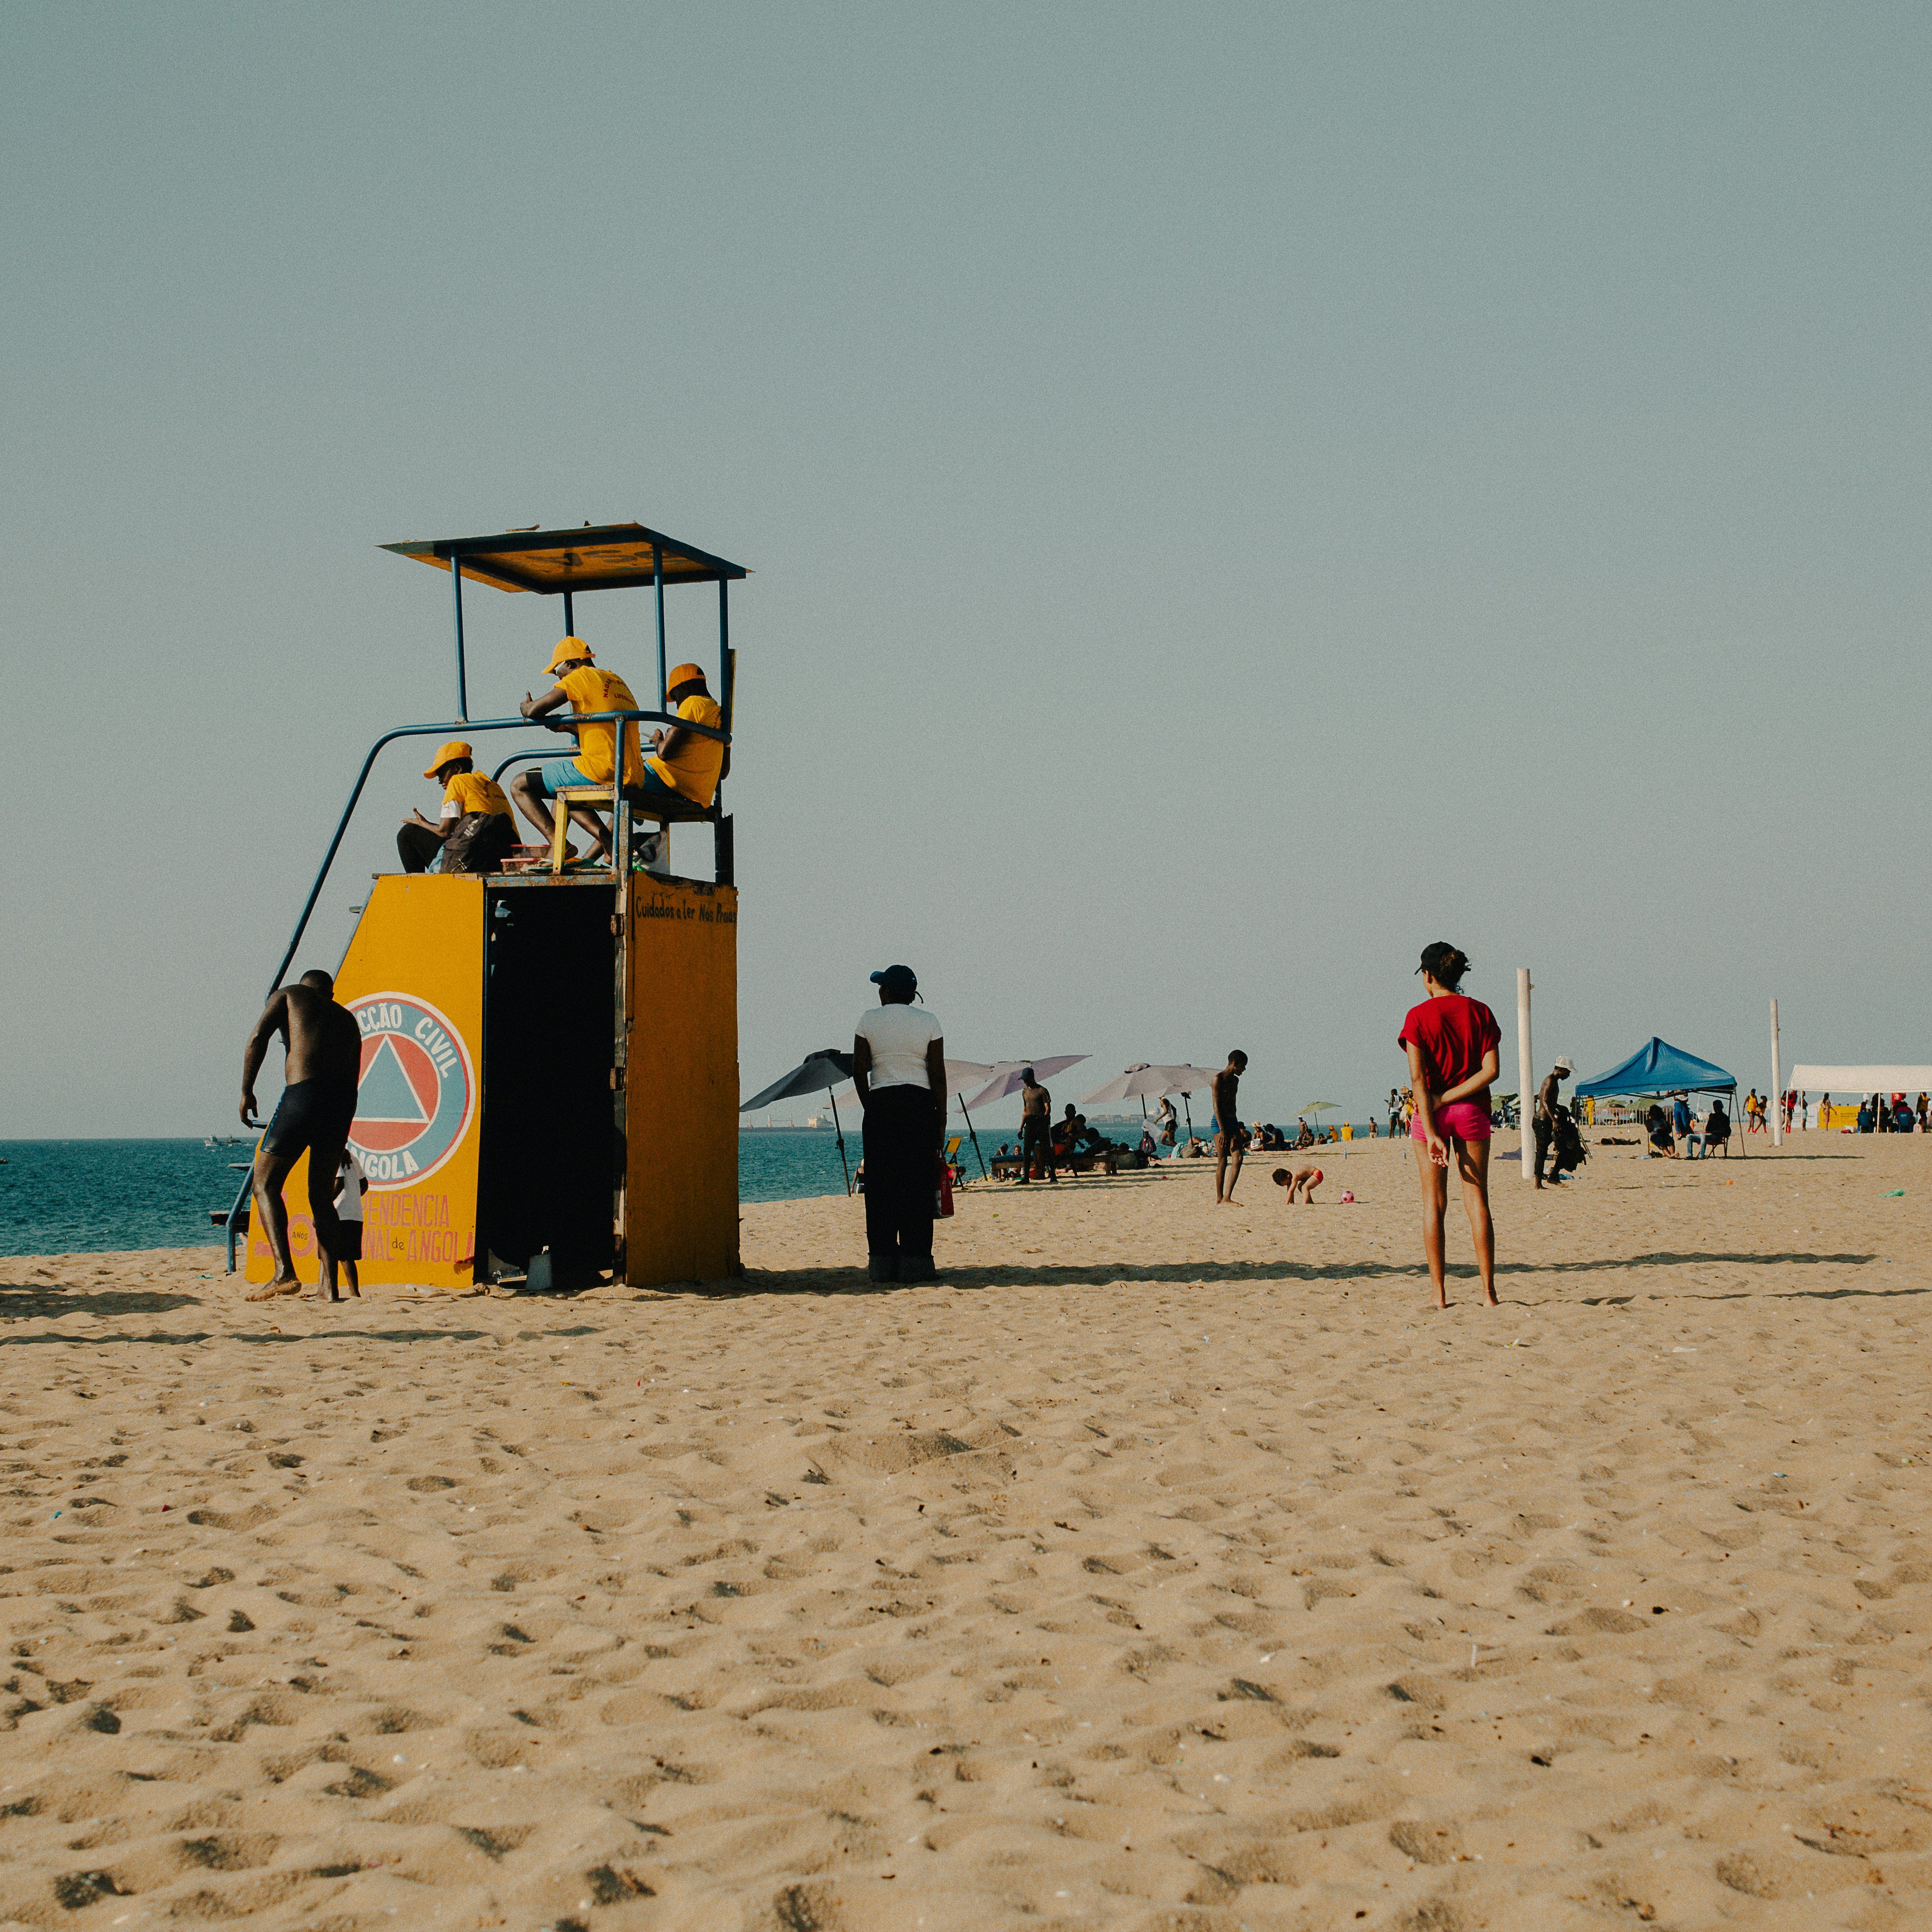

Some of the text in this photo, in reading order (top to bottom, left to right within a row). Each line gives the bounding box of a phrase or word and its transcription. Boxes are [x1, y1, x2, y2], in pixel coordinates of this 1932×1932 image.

[636, 895, 674, 919] Cuidados
[677, 908, 681, 919] a
[699, 903, 714, 923] Nas
[716, 902, 737, 925] Praias
[415, 1017, 457, 1078] CIVIL
[292, 1231, 308, 1240] ANOS
[392, 1237, 404, 1250] de
[407, 1229, 475, 1263] ANGOLA
